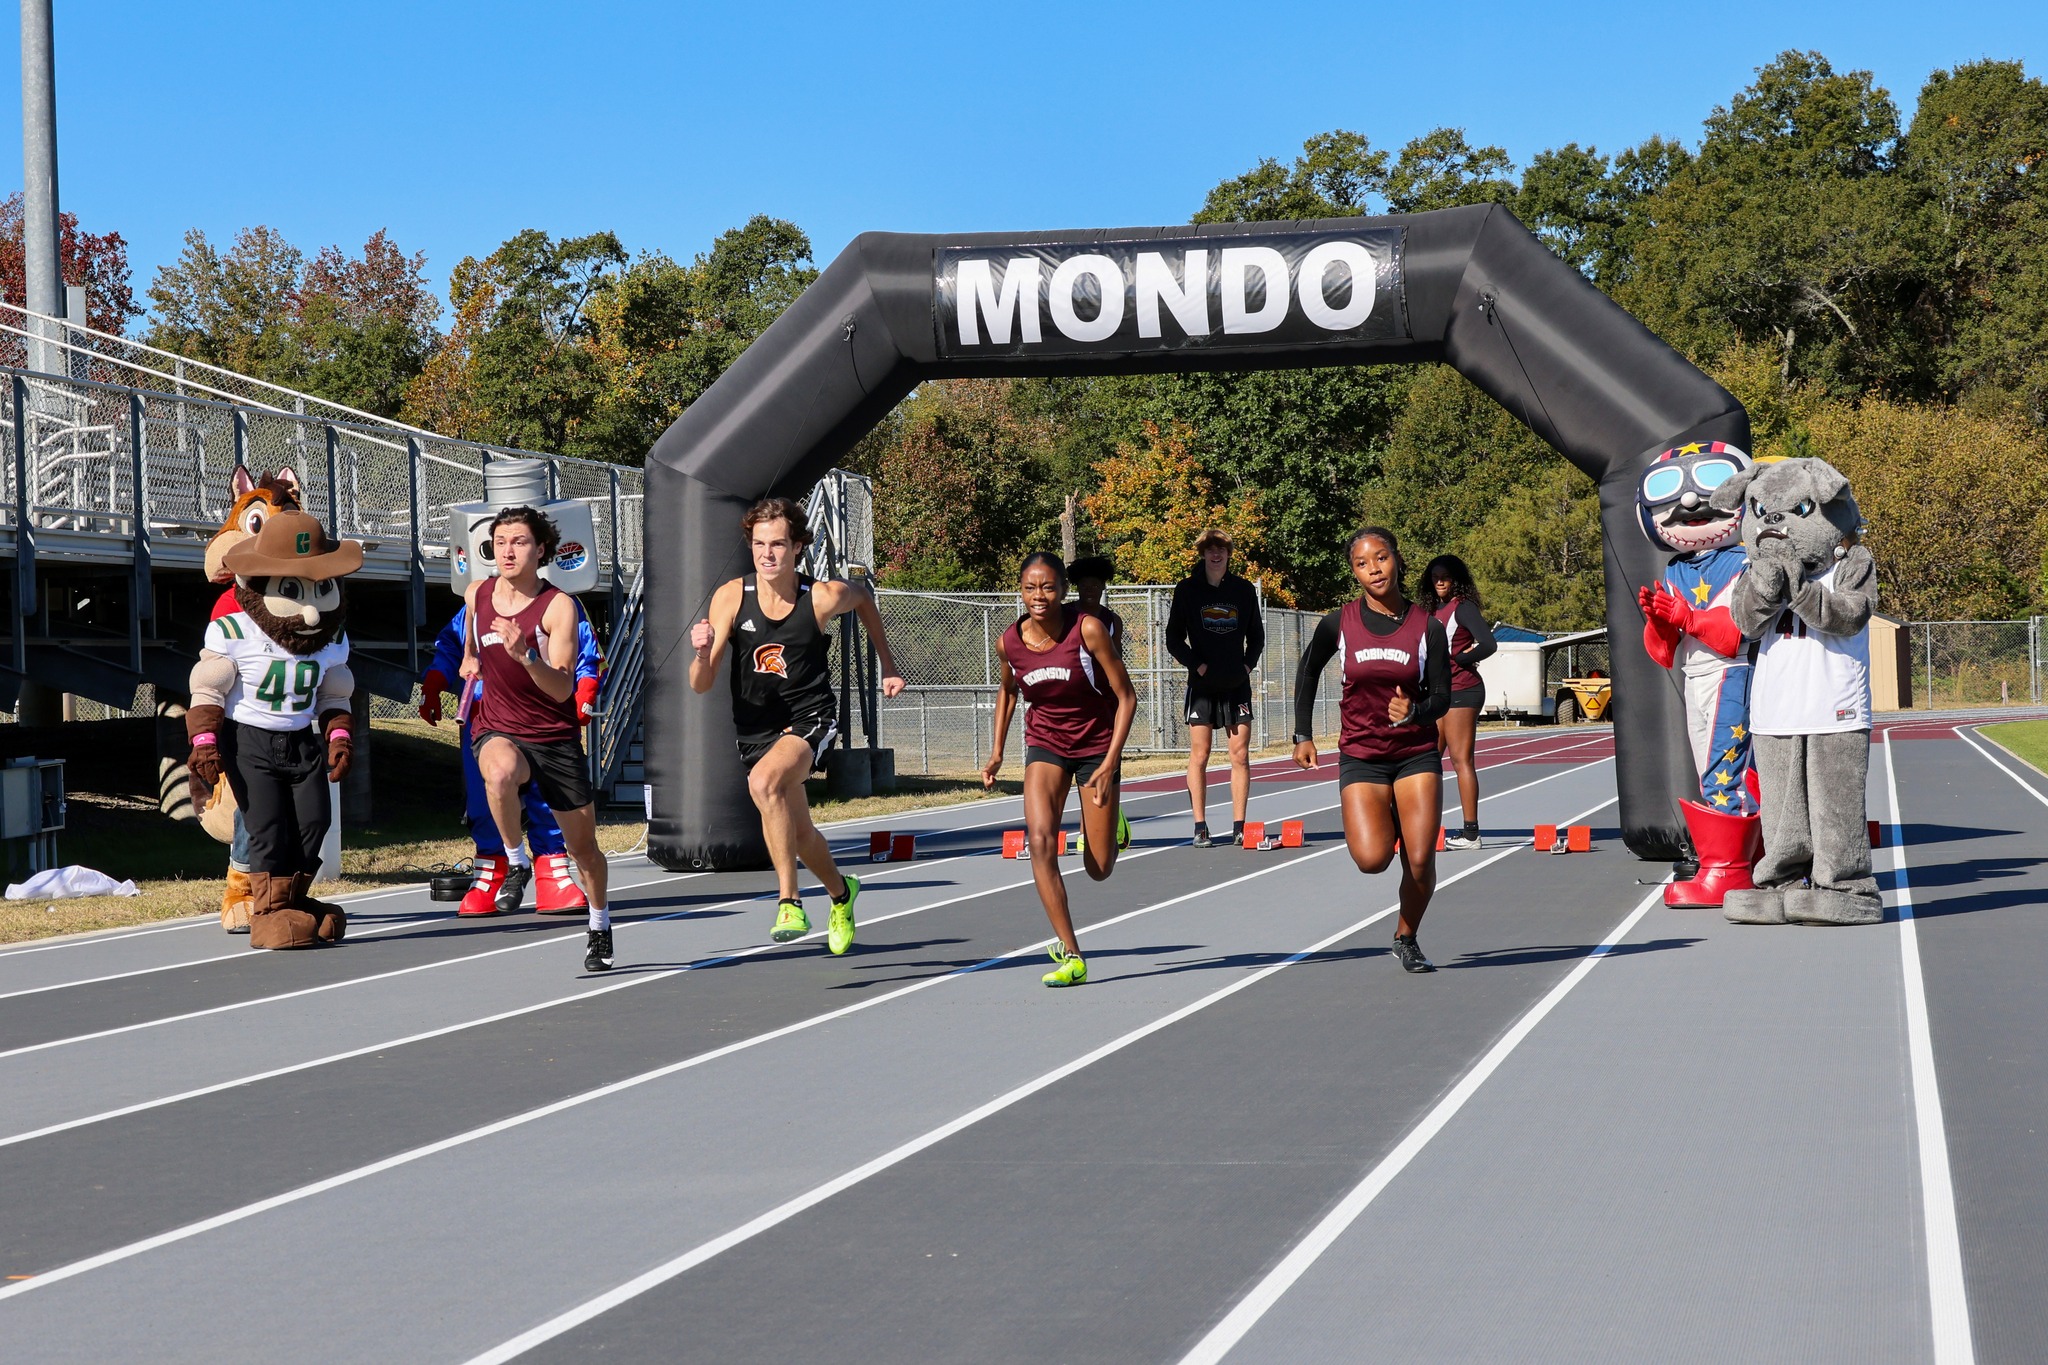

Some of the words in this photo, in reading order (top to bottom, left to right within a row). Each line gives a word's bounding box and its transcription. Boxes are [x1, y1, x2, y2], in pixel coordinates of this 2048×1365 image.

[956, 241, 1376, 346] MONDO
[1355, 648, 1410, 666] ROBINSON
[256, 660, 320, 711] 49
[1022, 666, 1071, 687] ROBINSON
[1238, 702, 1250, 716] N
